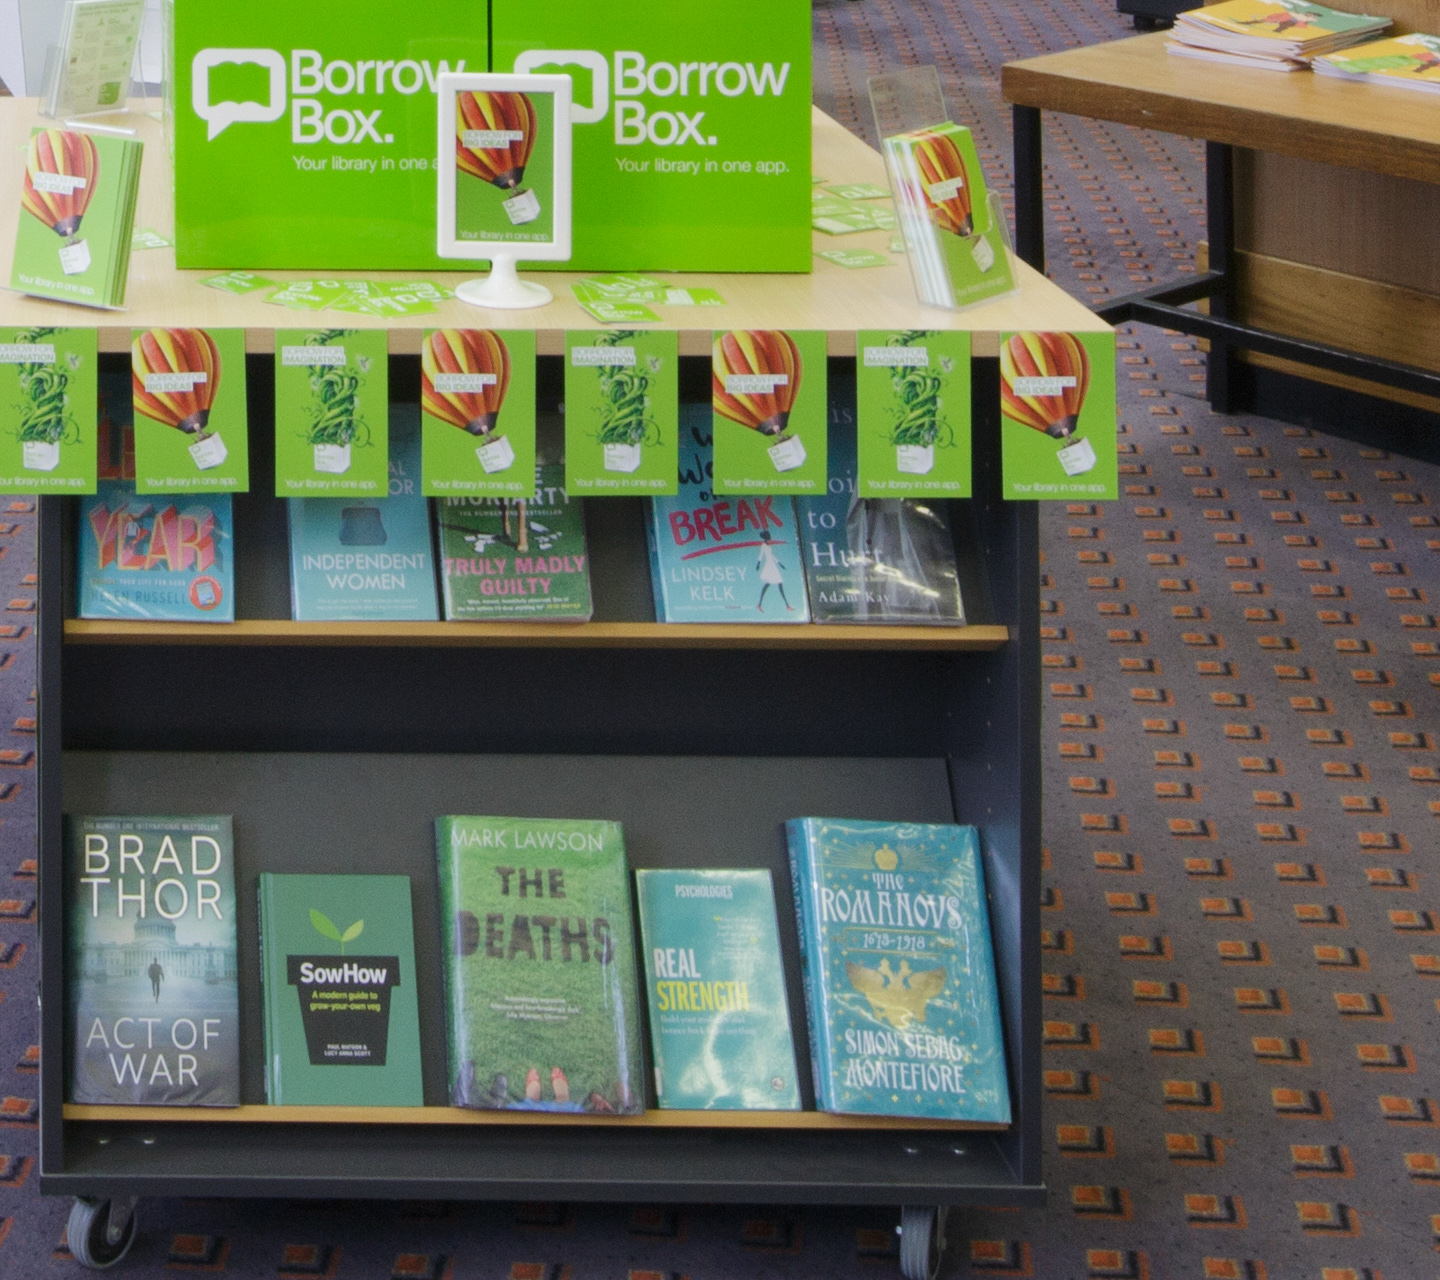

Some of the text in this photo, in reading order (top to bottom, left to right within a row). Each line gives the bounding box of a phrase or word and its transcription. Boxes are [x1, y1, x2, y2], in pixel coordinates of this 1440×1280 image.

[615, 50, 789, 96] Borrow
[291, 97, 394, 144] Box.
[615, 99, 717, 147] Box.
[464, 131, 501, 140] BORROW
[464, 140, 509, 148] BIG IDEAS
[293, 155, 427, 174] Your library in one
[616, 157, 790, 178] Your library in one app.
[146, 382, 192, 391] BIG IDEAS
[14, 477, 39, 488] library
[49, 479, 65, 487] one
[668, 496, 784, 546] BREAK
[808, 510, 837, 530] to
[89, 502, 217, 572] YEAR
[303, 553, 426, 571] INDEPENDENT
[445, 555, 586, 575] TRULY MADLY
[812, 541, 884, 568] Hurt
[326, 573, 406, 590] WOMEN
[671, 566, 747, 583] LINDSEY
[135, 590, 187, 604] RUSSELL
[479, 577, 552, 595] GUILTY
[689, 585, 735, 602] KELK
[818, 591, 891, 606] Adam Kay
[451, 828, 603, 852] MARK LAWSON
[83, 833, 222, 875] BRAD
[495, 866, 567, 899] THE
[675, 884, 734, 900] PSYCHOLOGIES
[872, 873, 904, 890] THE
[80, 877, 223, 920] THOR
[821, 887, 963, 930] ROMANOVS
[453, 910, 616, 965] DEATHS
[300, 962, 387, 985] SowHow
[654, 948, 701, 978] REAL
[309, 1002, 381, 1013] grow-your-own veg
[312, 991, 378, 1002] A modern guide to
[657, 981, 750, 1012] STRENGTH
[86, 1017, 221, 1050] ACT OF
[845, 1028, 964, 1061] SIMON SEBAG
[109, 1052, 199, 1086] WAR
[845, 1058, 967, 1094] MONTEFIORE
